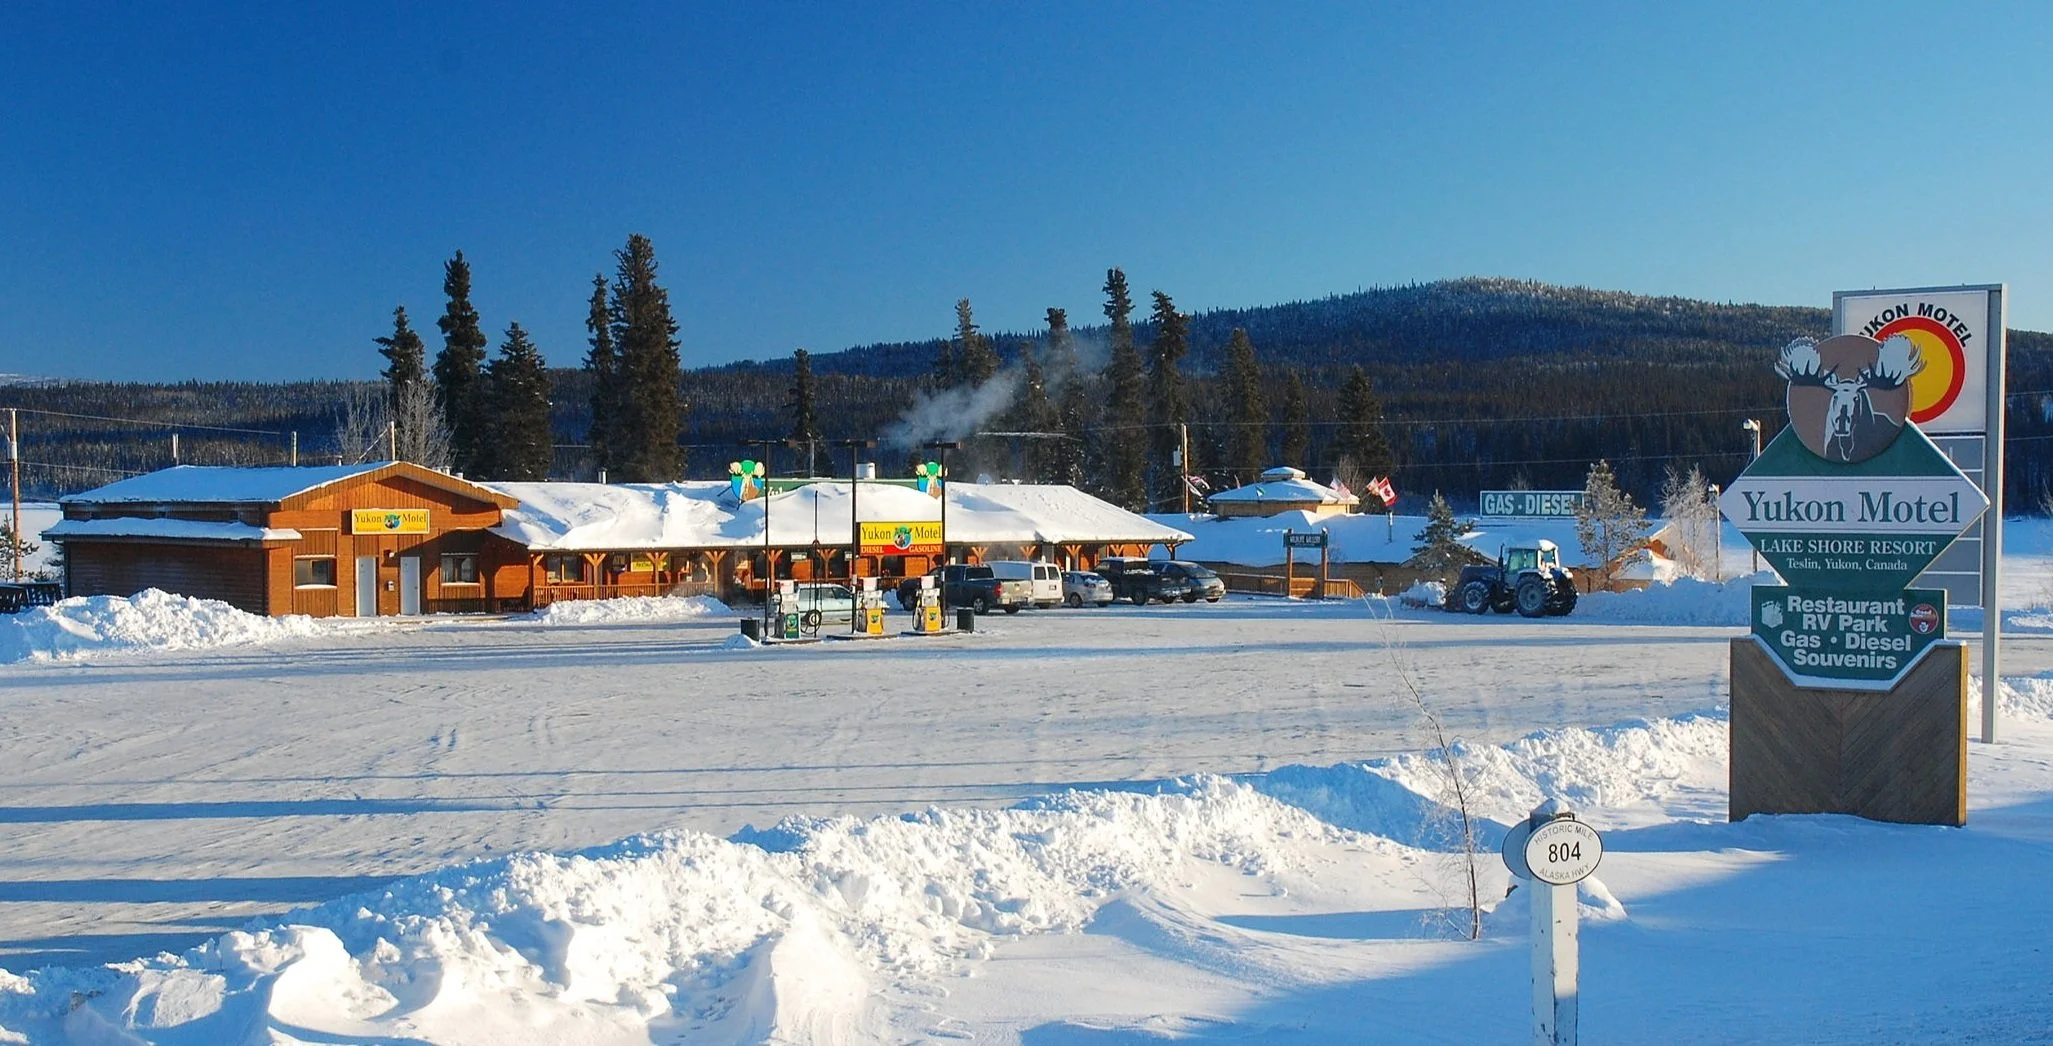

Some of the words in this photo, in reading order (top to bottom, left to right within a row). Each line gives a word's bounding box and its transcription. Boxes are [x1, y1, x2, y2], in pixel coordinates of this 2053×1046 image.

[1859, 303, 1909, 338] UKON
[1917, 302, 1972, 348] MOTEL
[1484, 494, 1514, 515] GAS
[1742, 491, 1845, 523] Yukon
[1857, 491, 1960, 524] Motel
[354, 513, 382, 523] Yukon
[402, 513, 427, 523] Motel
[861, 526, 891, 540] Yukon
[914, 526, 942, 539] Motel
[861, 546, 884, 554] DIESEL
[909, 545, 942, 553] GASOLINE
[1760, 539, 1803, 554] LAKE
[1807, 540, 1865, 555] SHORE
[1870, 541, 1937, 556] RESORT
[1786, 558, 1821, 570] Teslin,
[1825, 559, 1862, 571] Yukon,
[1865, 559, 1908, 571] Canada
[1787, 595, 1905, 616] Restaurant
[1802, 614, 1832, 631] RV
[1838, 615, 1888, 633] Park
[1780, 630, 1821, 649] Gas
[1845, 633, 1912, 652] Diesel
[1793, 649, 1897, 670] Souvenirs
[1535, 824, 1573, 845] HISTORIC
[1574, 825, 1594, 841] MILE
[1548, 841, 1581, 863] 804
[1539, 867, 1571, 880] ALASKA
[1572, 863, 1590, 878] HWY
